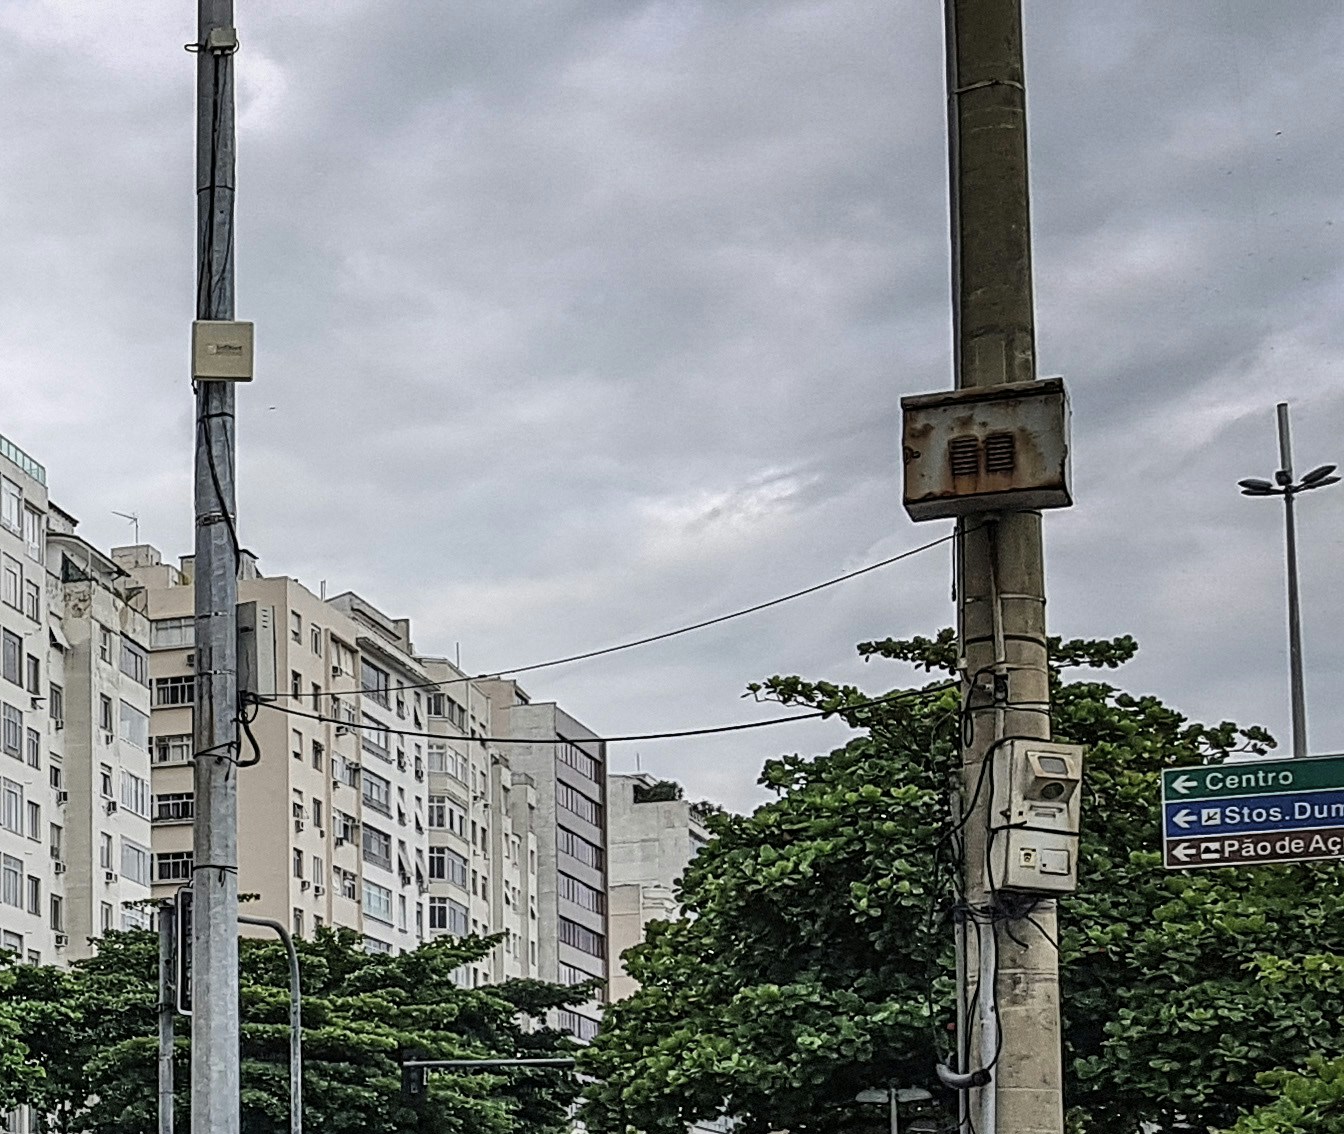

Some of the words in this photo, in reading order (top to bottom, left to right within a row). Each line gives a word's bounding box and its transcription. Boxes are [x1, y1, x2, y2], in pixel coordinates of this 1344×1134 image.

[1205, 771, 1293, 790] Centro
[1224, 839, 1272, 858] Pão
[1275, 837, 1304, 854] de
[1308, 834, 1344, 855] Aç
